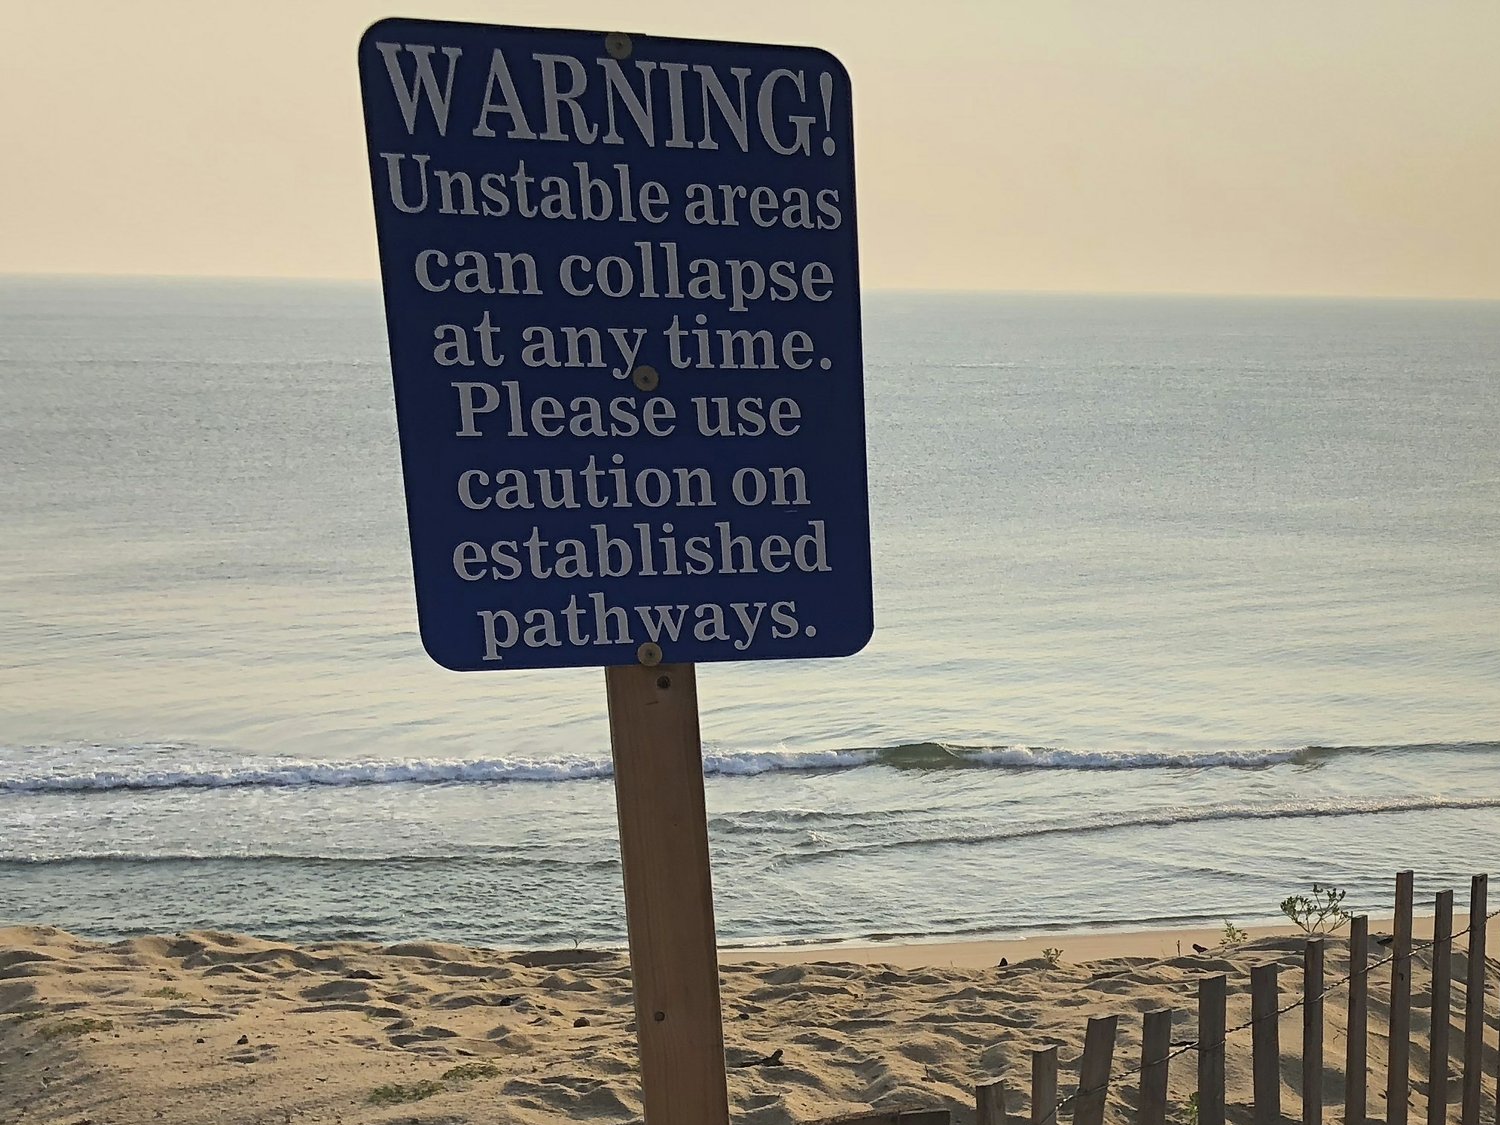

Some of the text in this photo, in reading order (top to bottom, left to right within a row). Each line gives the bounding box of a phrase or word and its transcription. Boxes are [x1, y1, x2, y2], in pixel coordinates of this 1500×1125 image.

[375, 41, 836, 157] WARNING!
[379, 152, 842, 230] Unstable areas
[414, 241, 834, 312] can collapse
[433, 310, 832, 380] at any time.
[450, 380, 802, 437] Please use
[457, 453, 811, 510] caution on
[452, 519, 833, 581] established
[476, 591, 817, 661] pathways.
